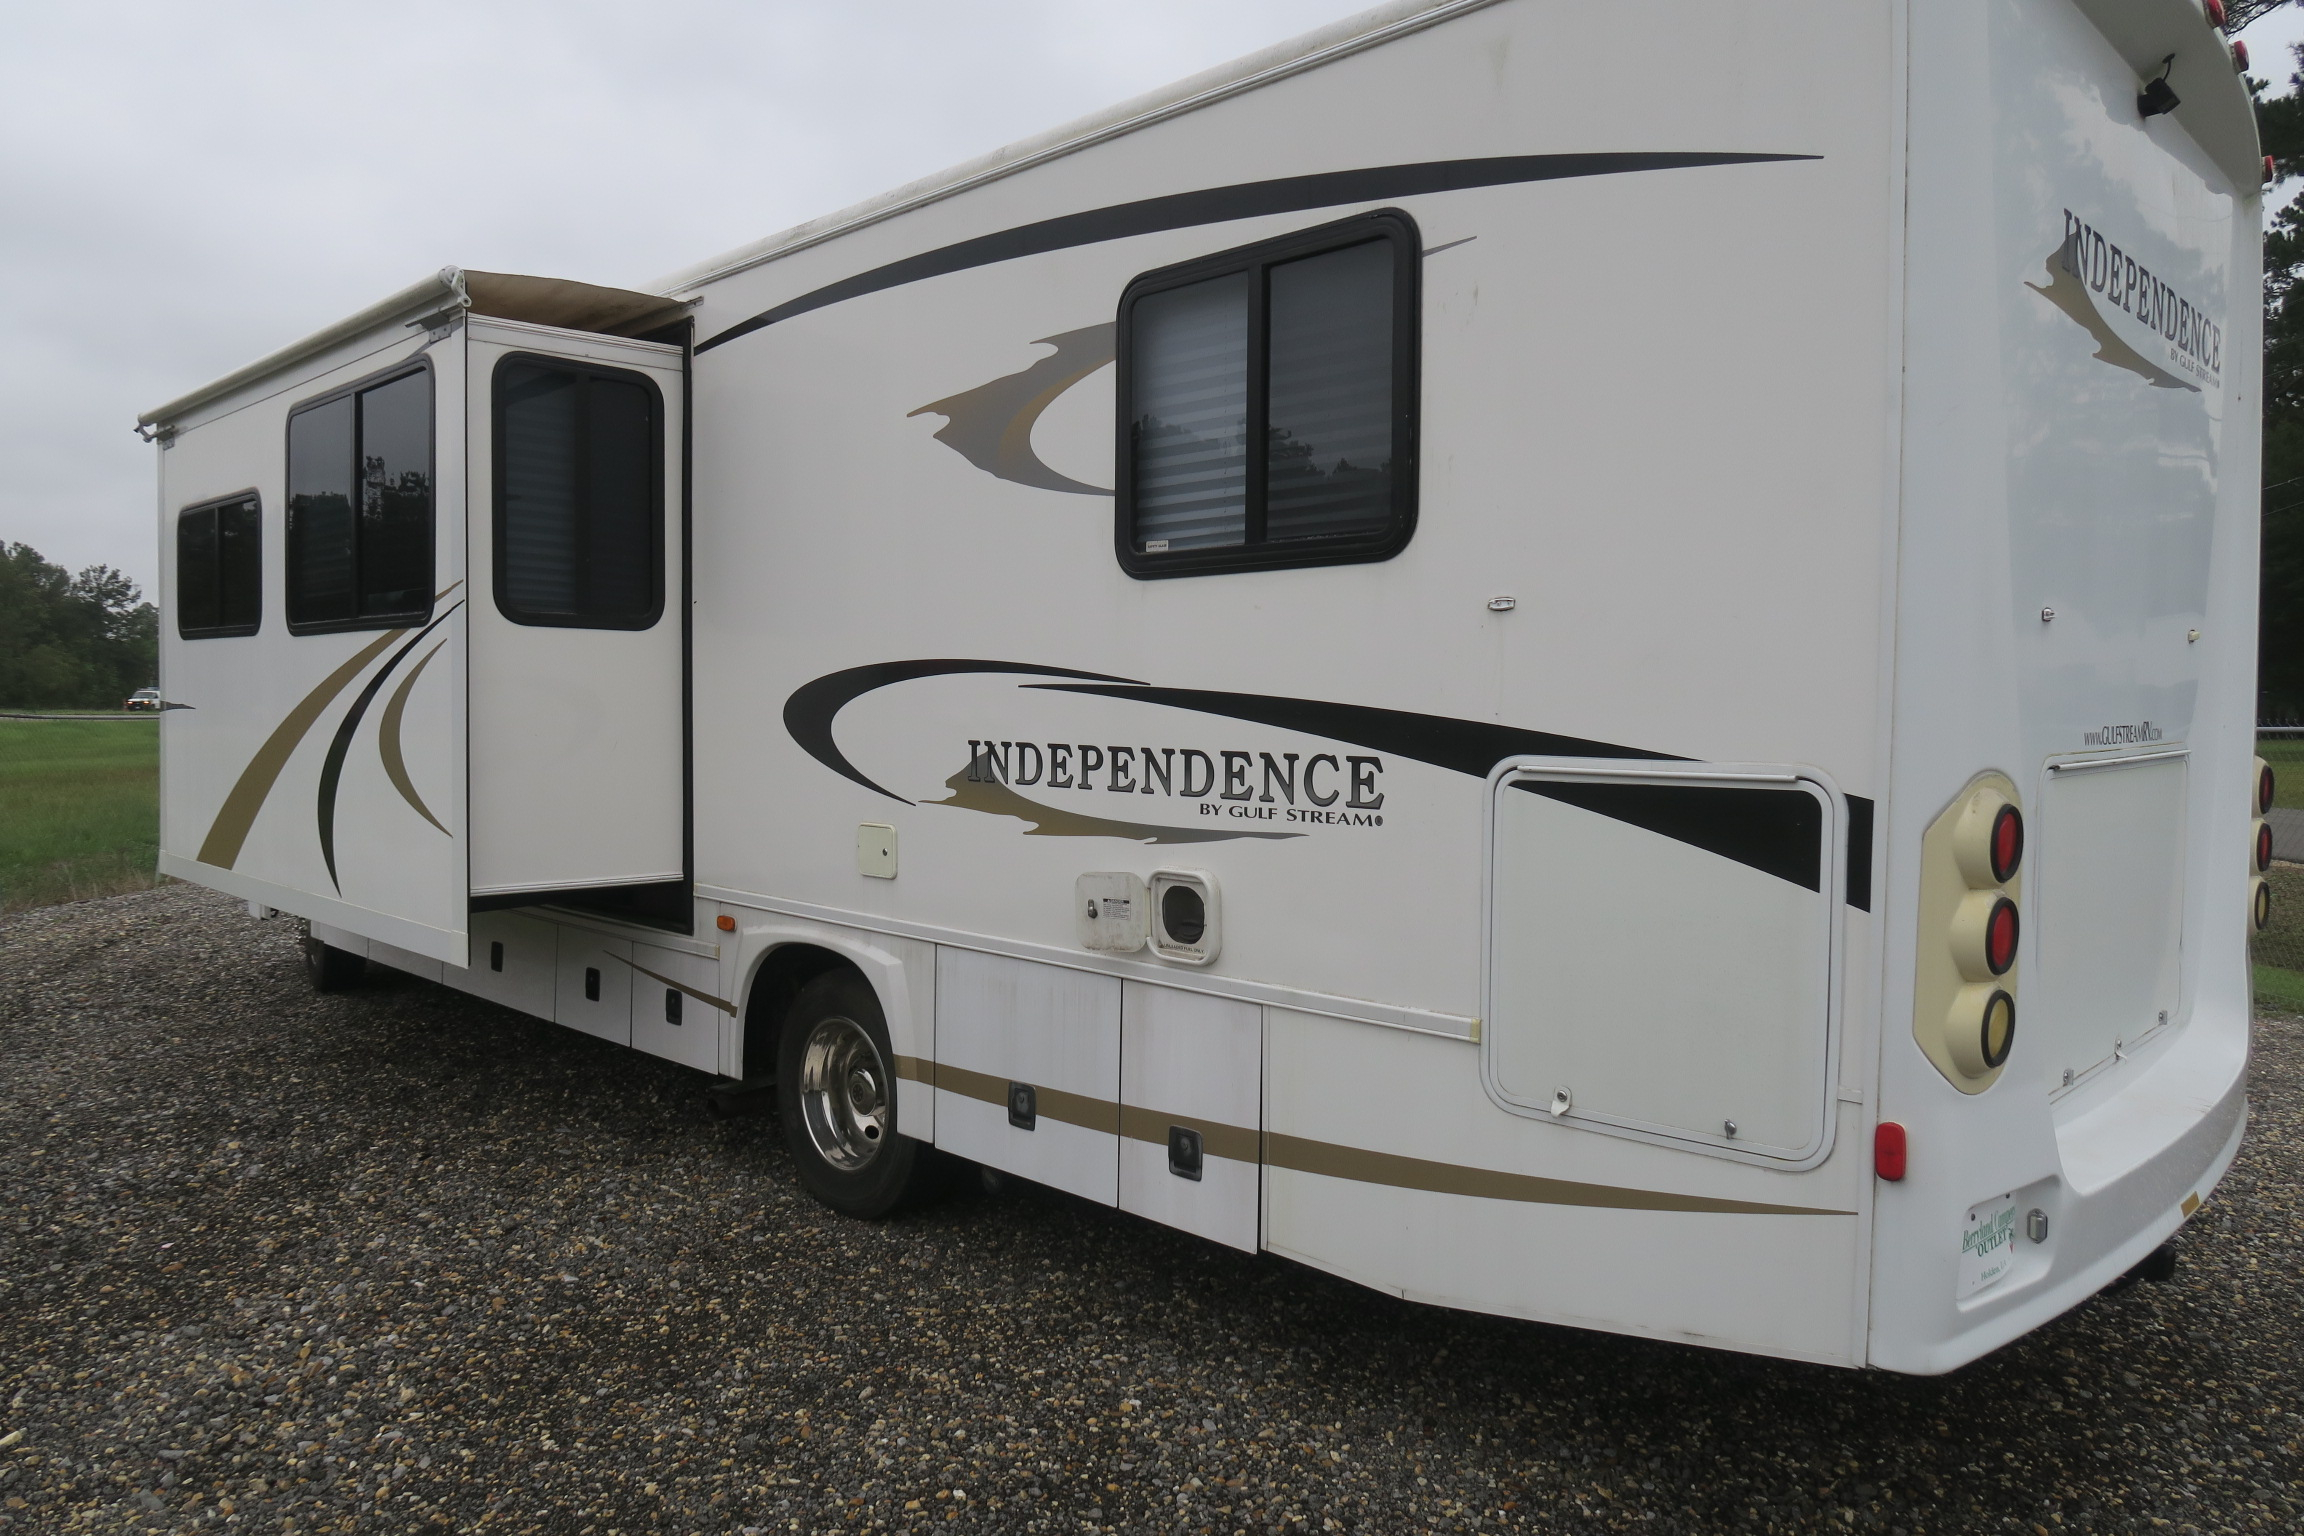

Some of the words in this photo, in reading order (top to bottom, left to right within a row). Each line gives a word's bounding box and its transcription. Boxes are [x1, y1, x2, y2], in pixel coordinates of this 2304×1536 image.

[2062, 208, 2221, 375] INDEPENDENCE
[2170, 348, 2178, 363] BY
[2180, 355, 2194, 372] GULF
[967, 739, 1385, 810] INDEPENDENCE
[1199, 803, 1222, 816] BY
[1228, 805, 1278, 820] GULF
